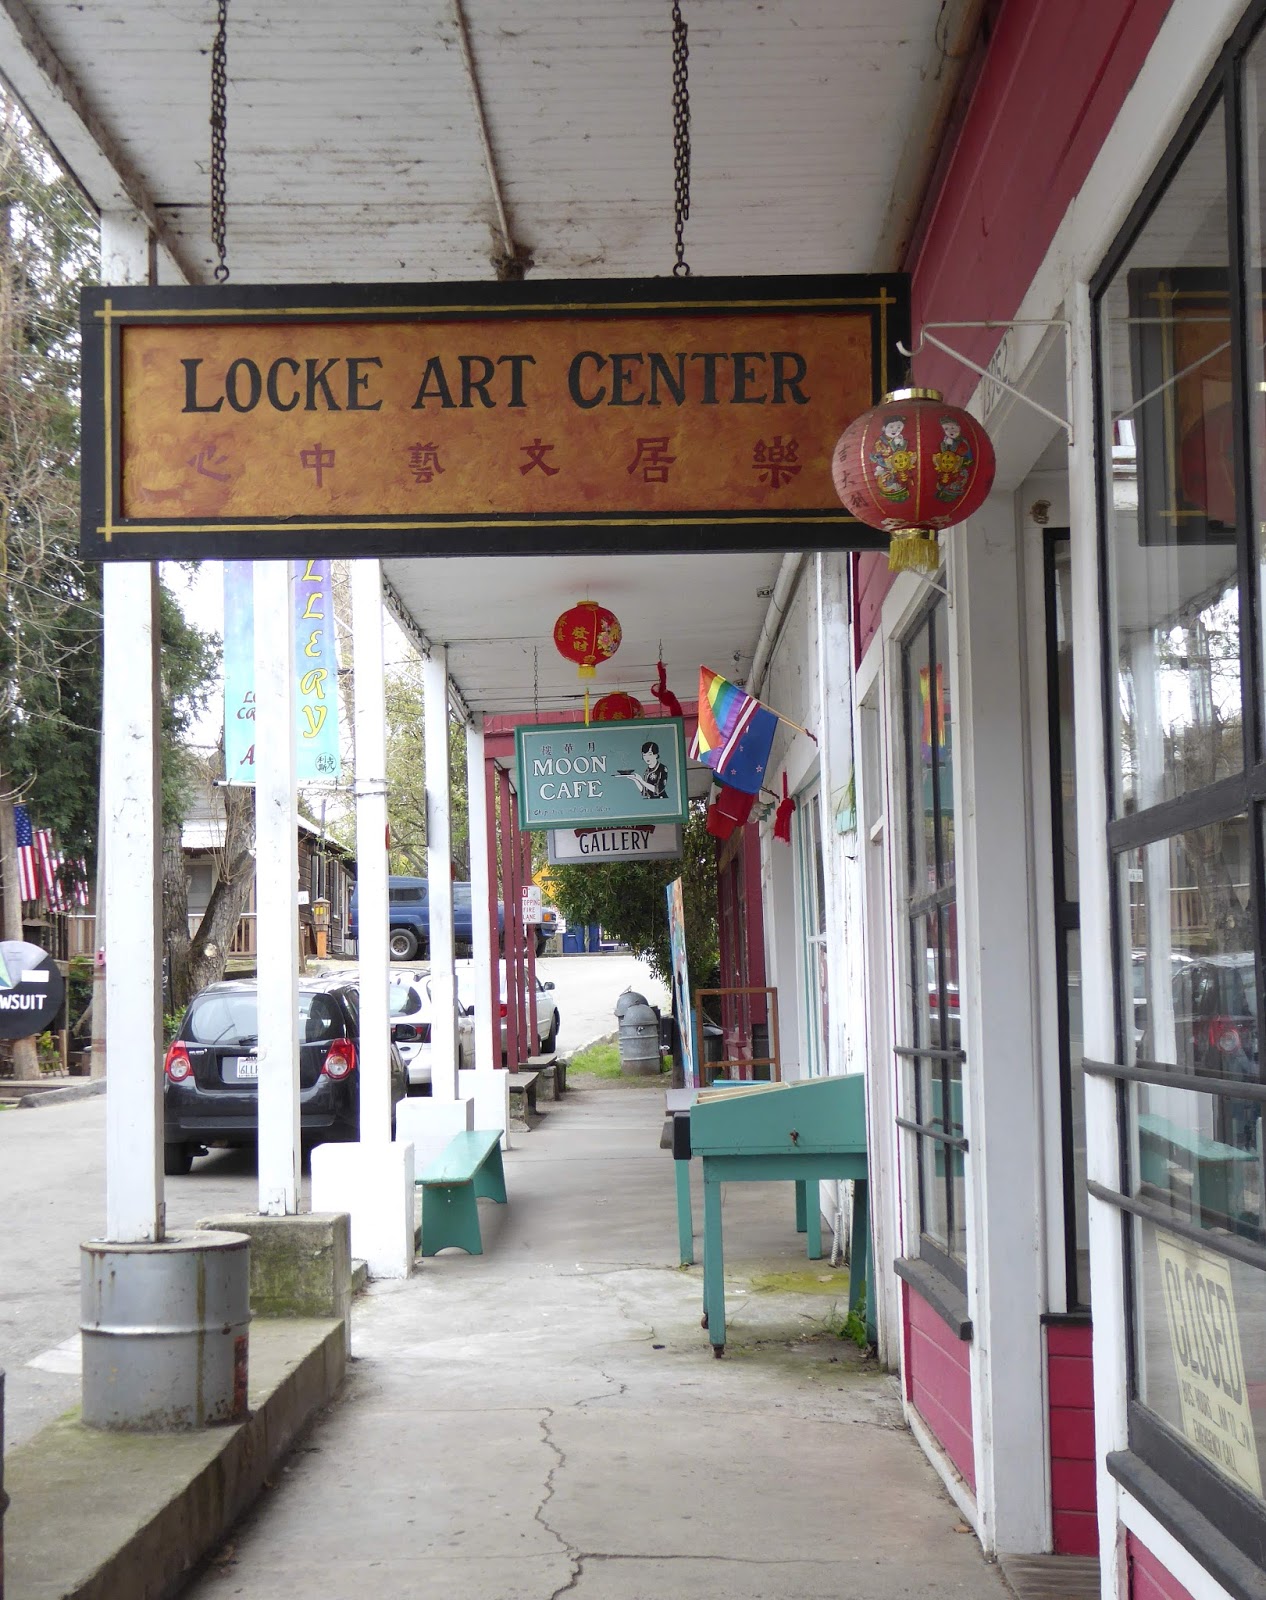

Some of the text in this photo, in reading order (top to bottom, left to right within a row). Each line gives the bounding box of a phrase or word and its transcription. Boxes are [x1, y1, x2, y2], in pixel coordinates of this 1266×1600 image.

[180, 350, 811, 413] LOCKE ART CENTER
[533, 755, 607, 776] MOON
[540, 780, 604, 800] CAFE
[580, 831, 650, 854] GALLERY
[1164, 1258, 1242, 1406] CLOSED
